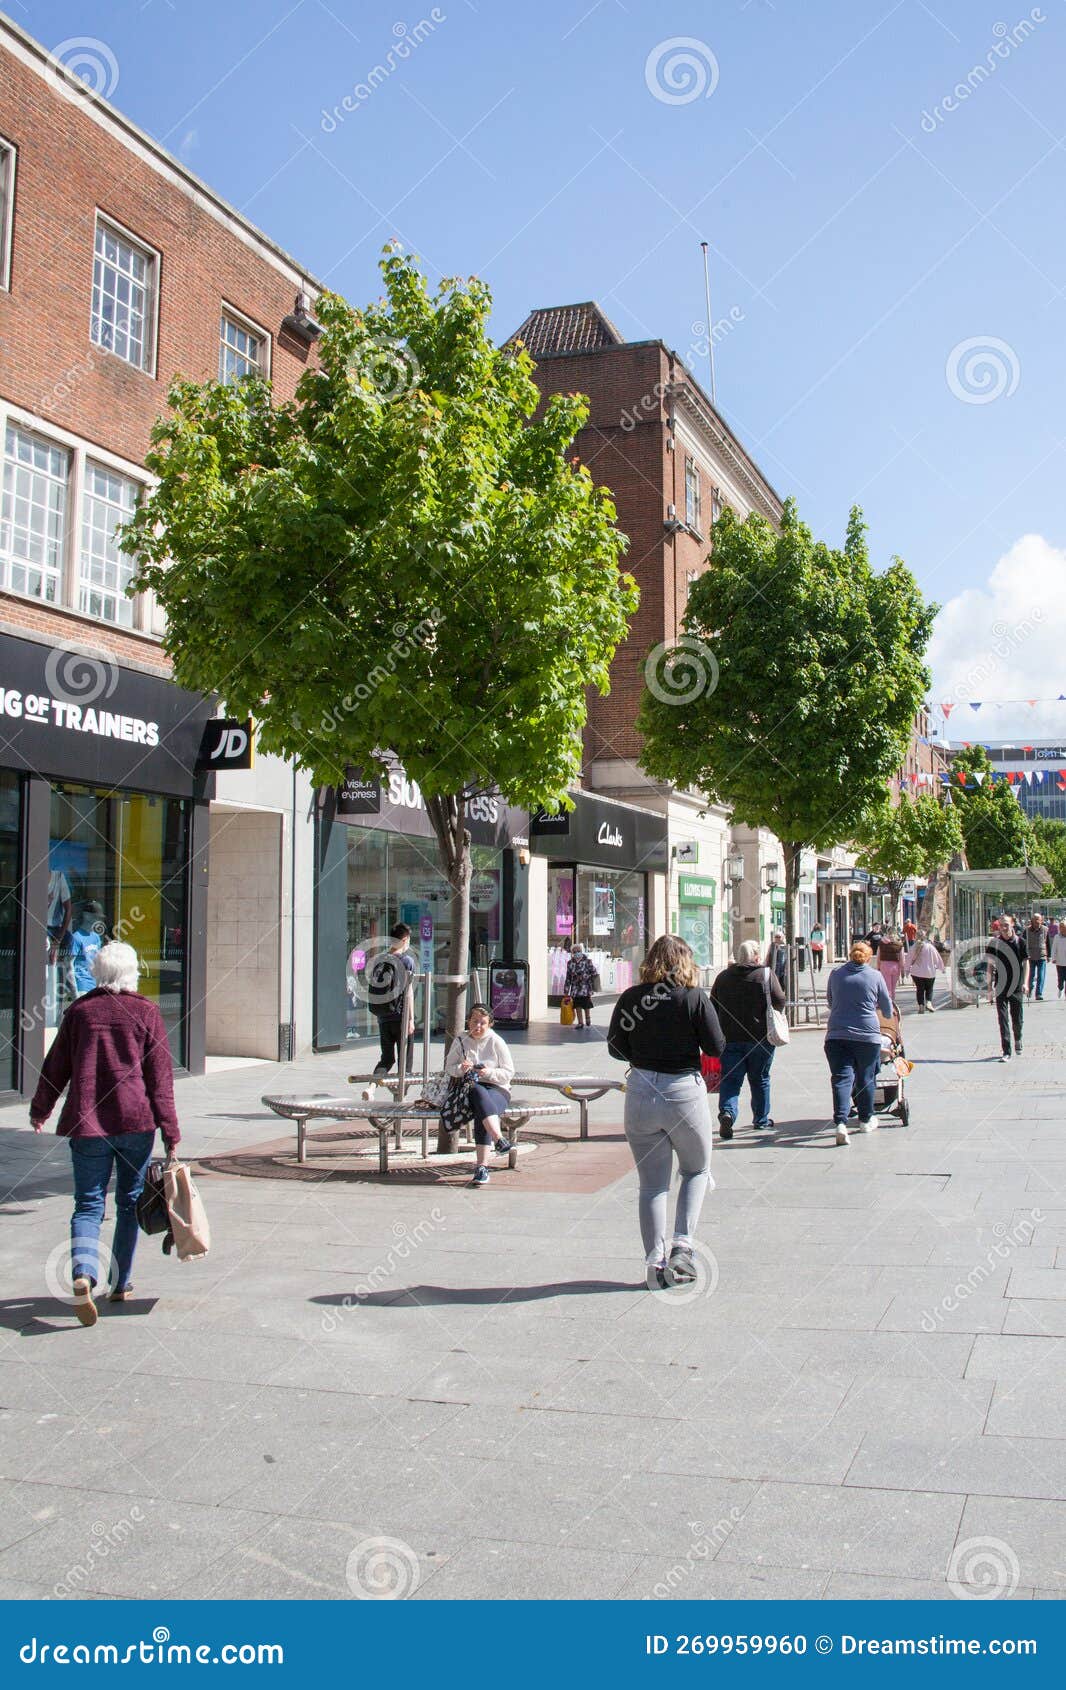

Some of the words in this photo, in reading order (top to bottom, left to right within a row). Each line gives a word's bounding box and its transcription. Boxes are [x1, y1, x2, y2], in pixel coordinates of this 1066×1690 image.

[25, 694, 49, 716] OF
[51, 700, 160, 747] TRAINERS
[210, 729, 248, 759] JD
[597, 821, 623, 847] Clarks
